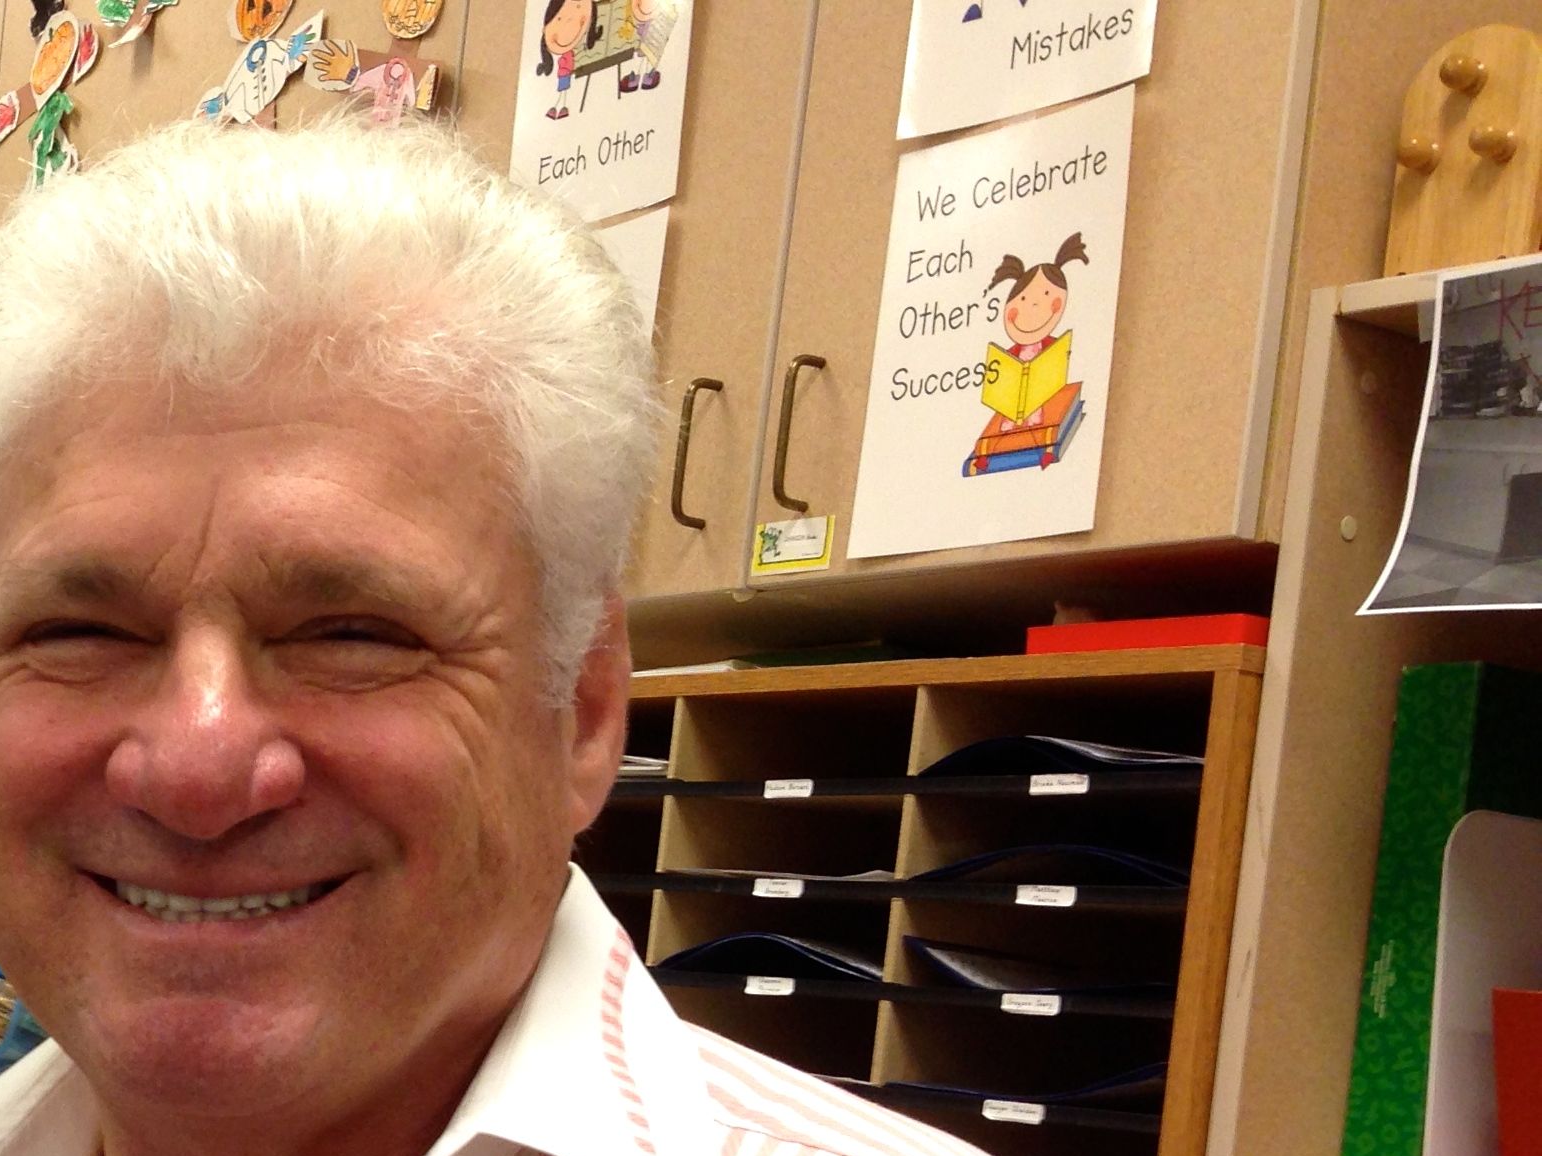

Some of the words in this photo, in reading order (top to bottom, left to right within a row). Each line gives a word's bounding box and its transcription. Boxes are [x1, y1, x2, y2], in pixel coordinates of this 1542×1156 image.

[1010, 8, 1134, 70] Mistakes
[538, 145, 587, 185] Each
[598, 129, 655, 166] Other
[917, 185, 956, 222] We
[972, 144, 1108, 209] Celebrate
[907, 239, 973, 283] Each
[899, 289, 1001, 339] Other's
[890, 359, 1001, 401] Success
